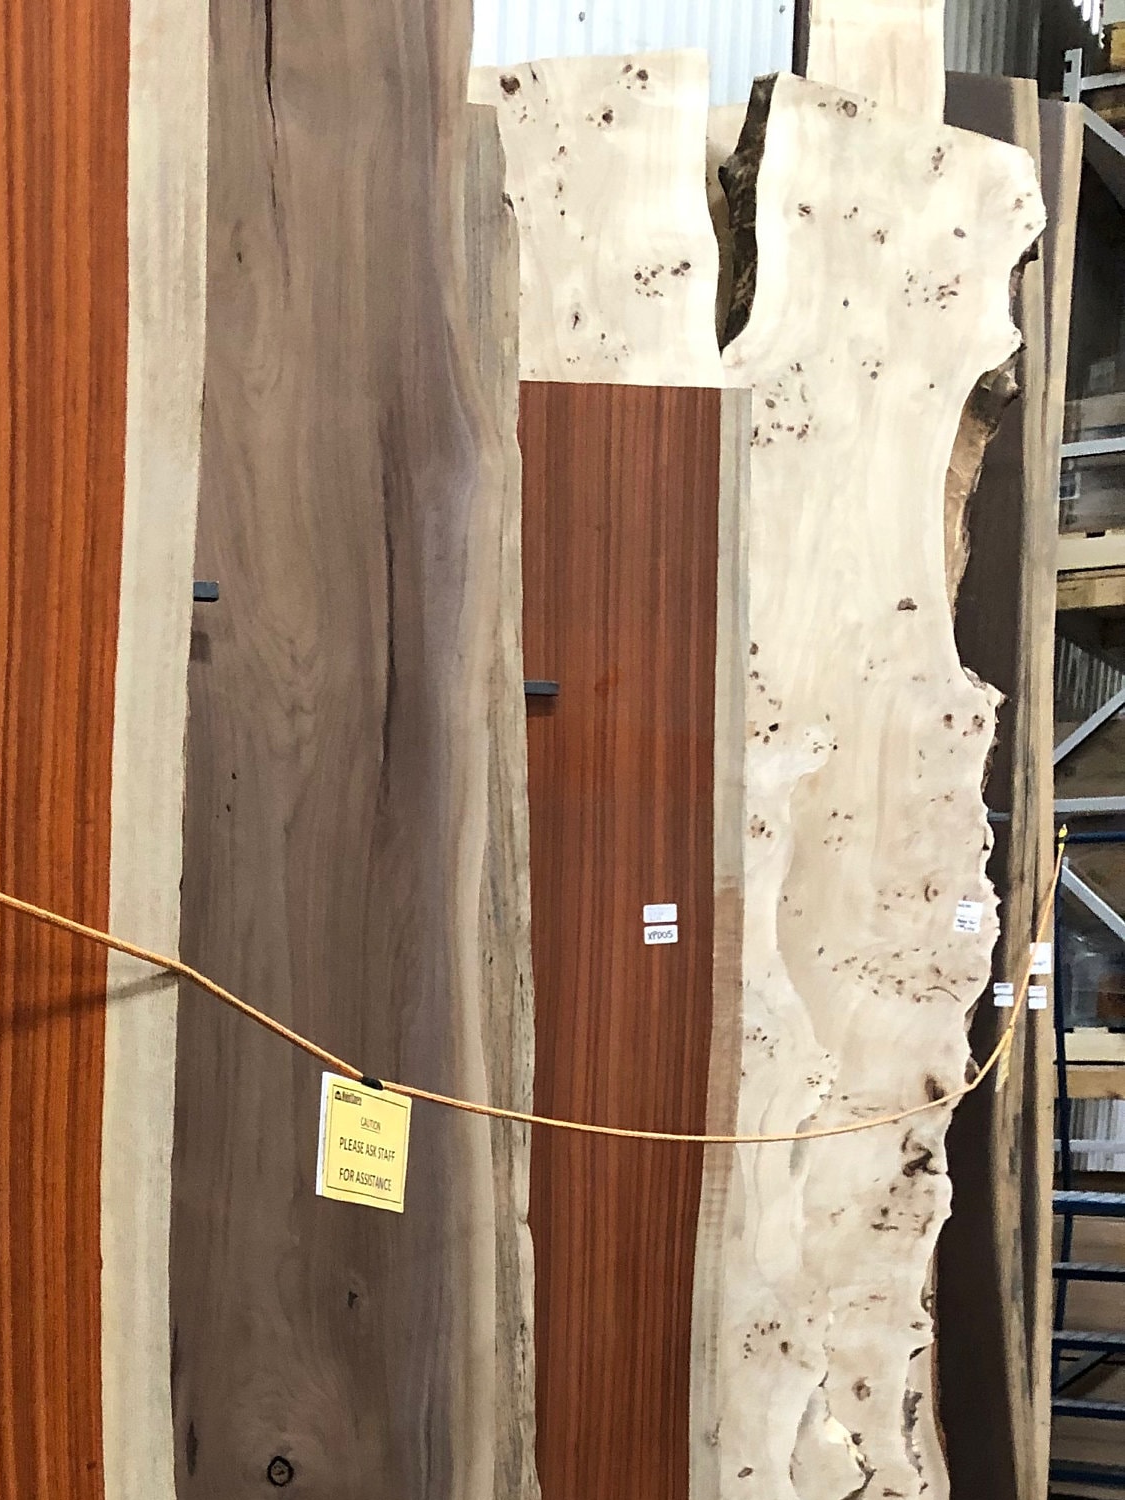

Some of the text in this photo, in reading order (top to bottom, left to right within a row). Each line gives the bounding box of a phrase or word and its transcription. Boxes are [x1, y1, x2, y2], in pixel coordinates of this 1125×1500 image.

[360, 1116, 381, 1131] CAUTION
[339, 1136, 396, 1163] PLEASE ASK STAFF
[339, 1167, 392, 1192] FOR ASSISTANCE
